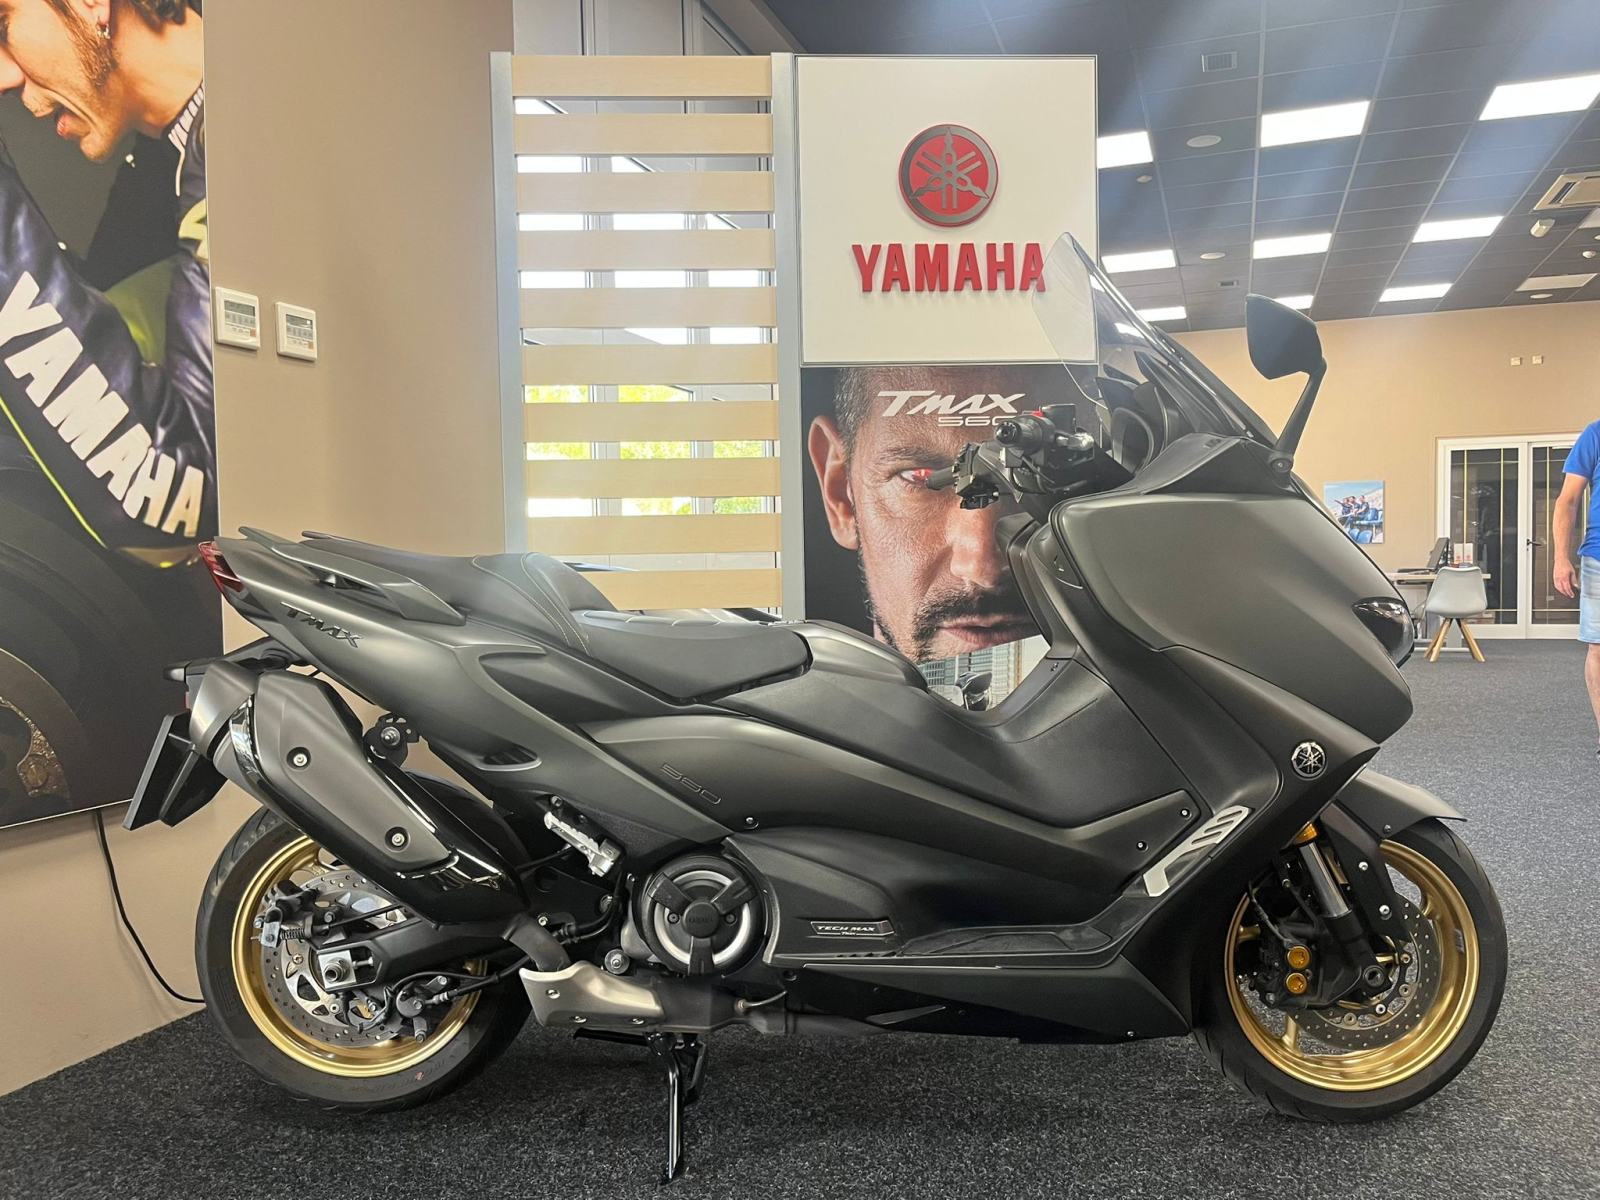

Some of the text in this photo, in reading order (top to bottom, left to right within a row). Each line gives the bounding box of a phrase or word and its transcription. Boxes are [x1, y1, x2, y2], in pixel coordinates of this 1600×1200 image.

[851, 242, 1046, 292] YAMAHA
[0, 271, 204, 537] YAMAHA
[877, 390, 1026, 417] TMAX
